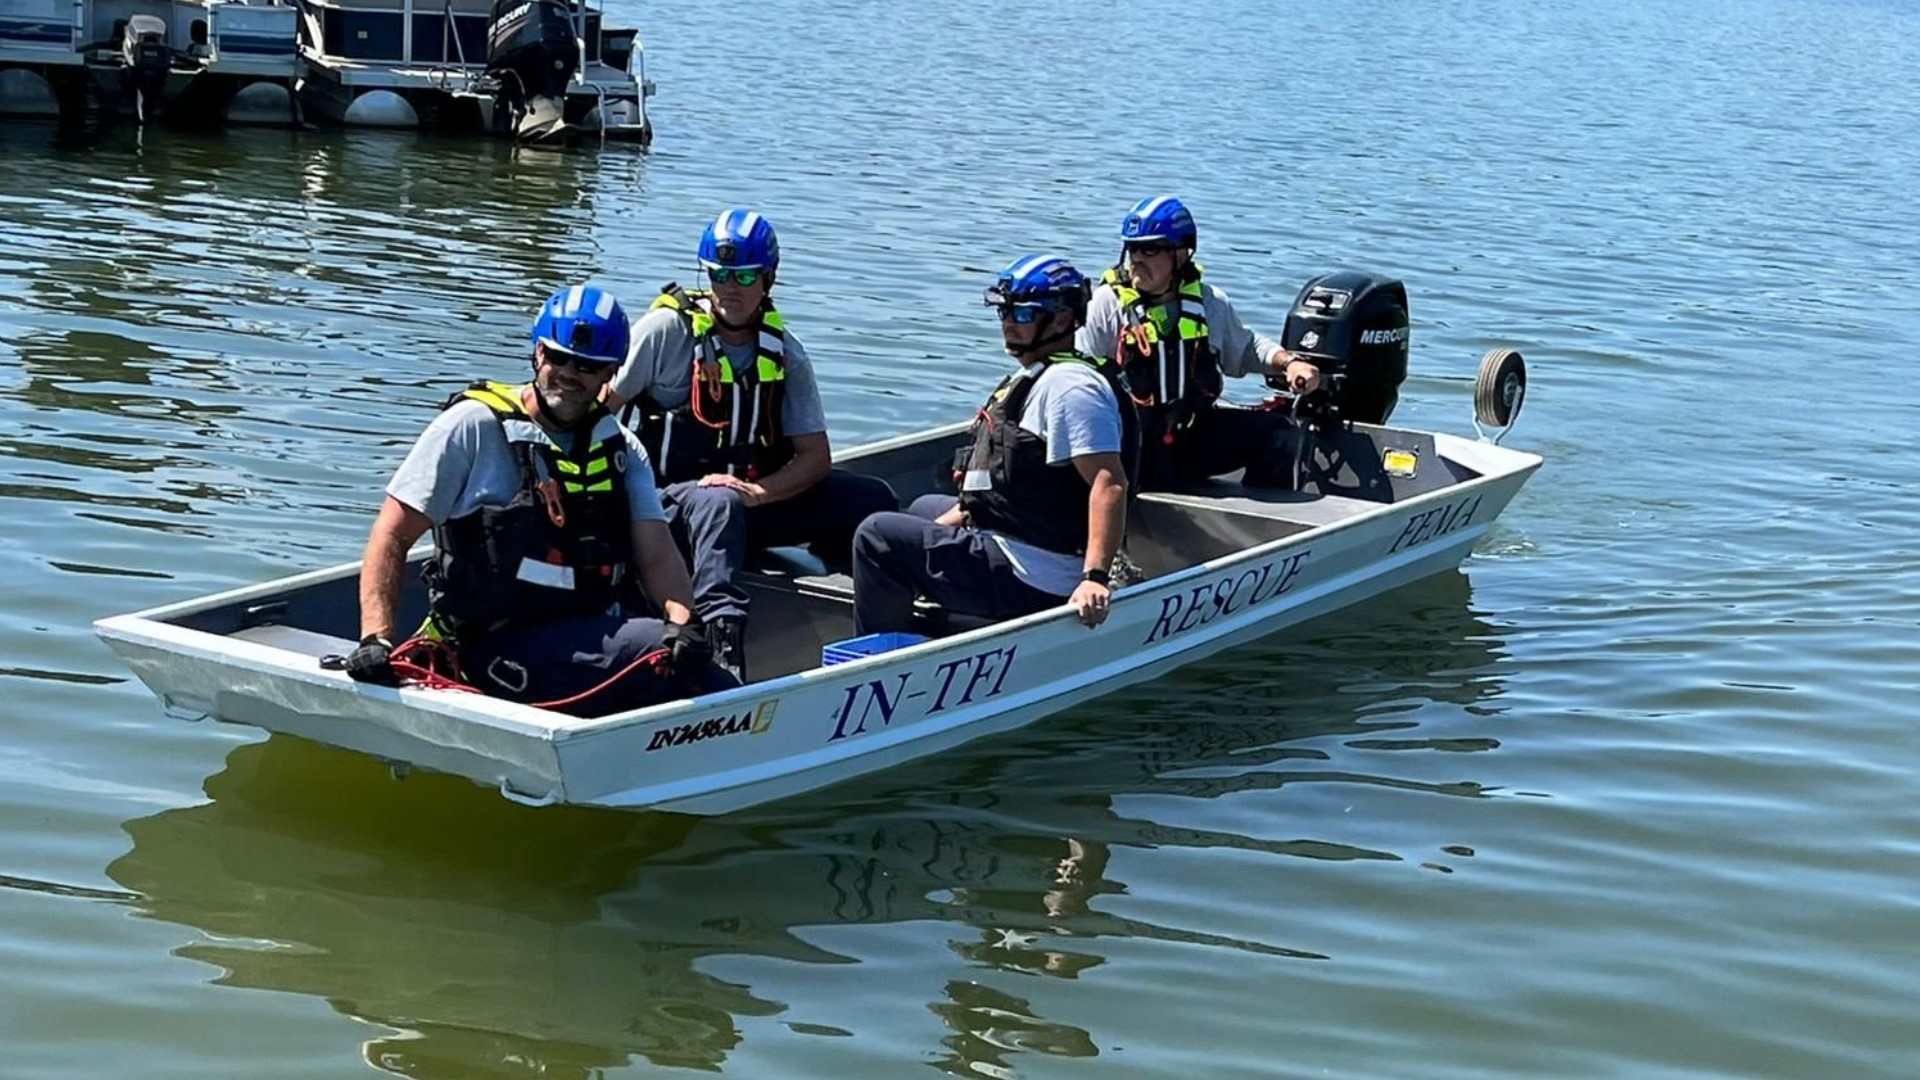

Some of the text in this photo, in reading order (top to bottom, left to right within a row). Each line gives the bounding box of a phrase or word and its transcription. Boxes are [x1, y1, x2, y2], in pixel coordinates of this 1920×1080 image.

[827, 494, 1483, 742] IN-TF1 RESCUE FEMA
